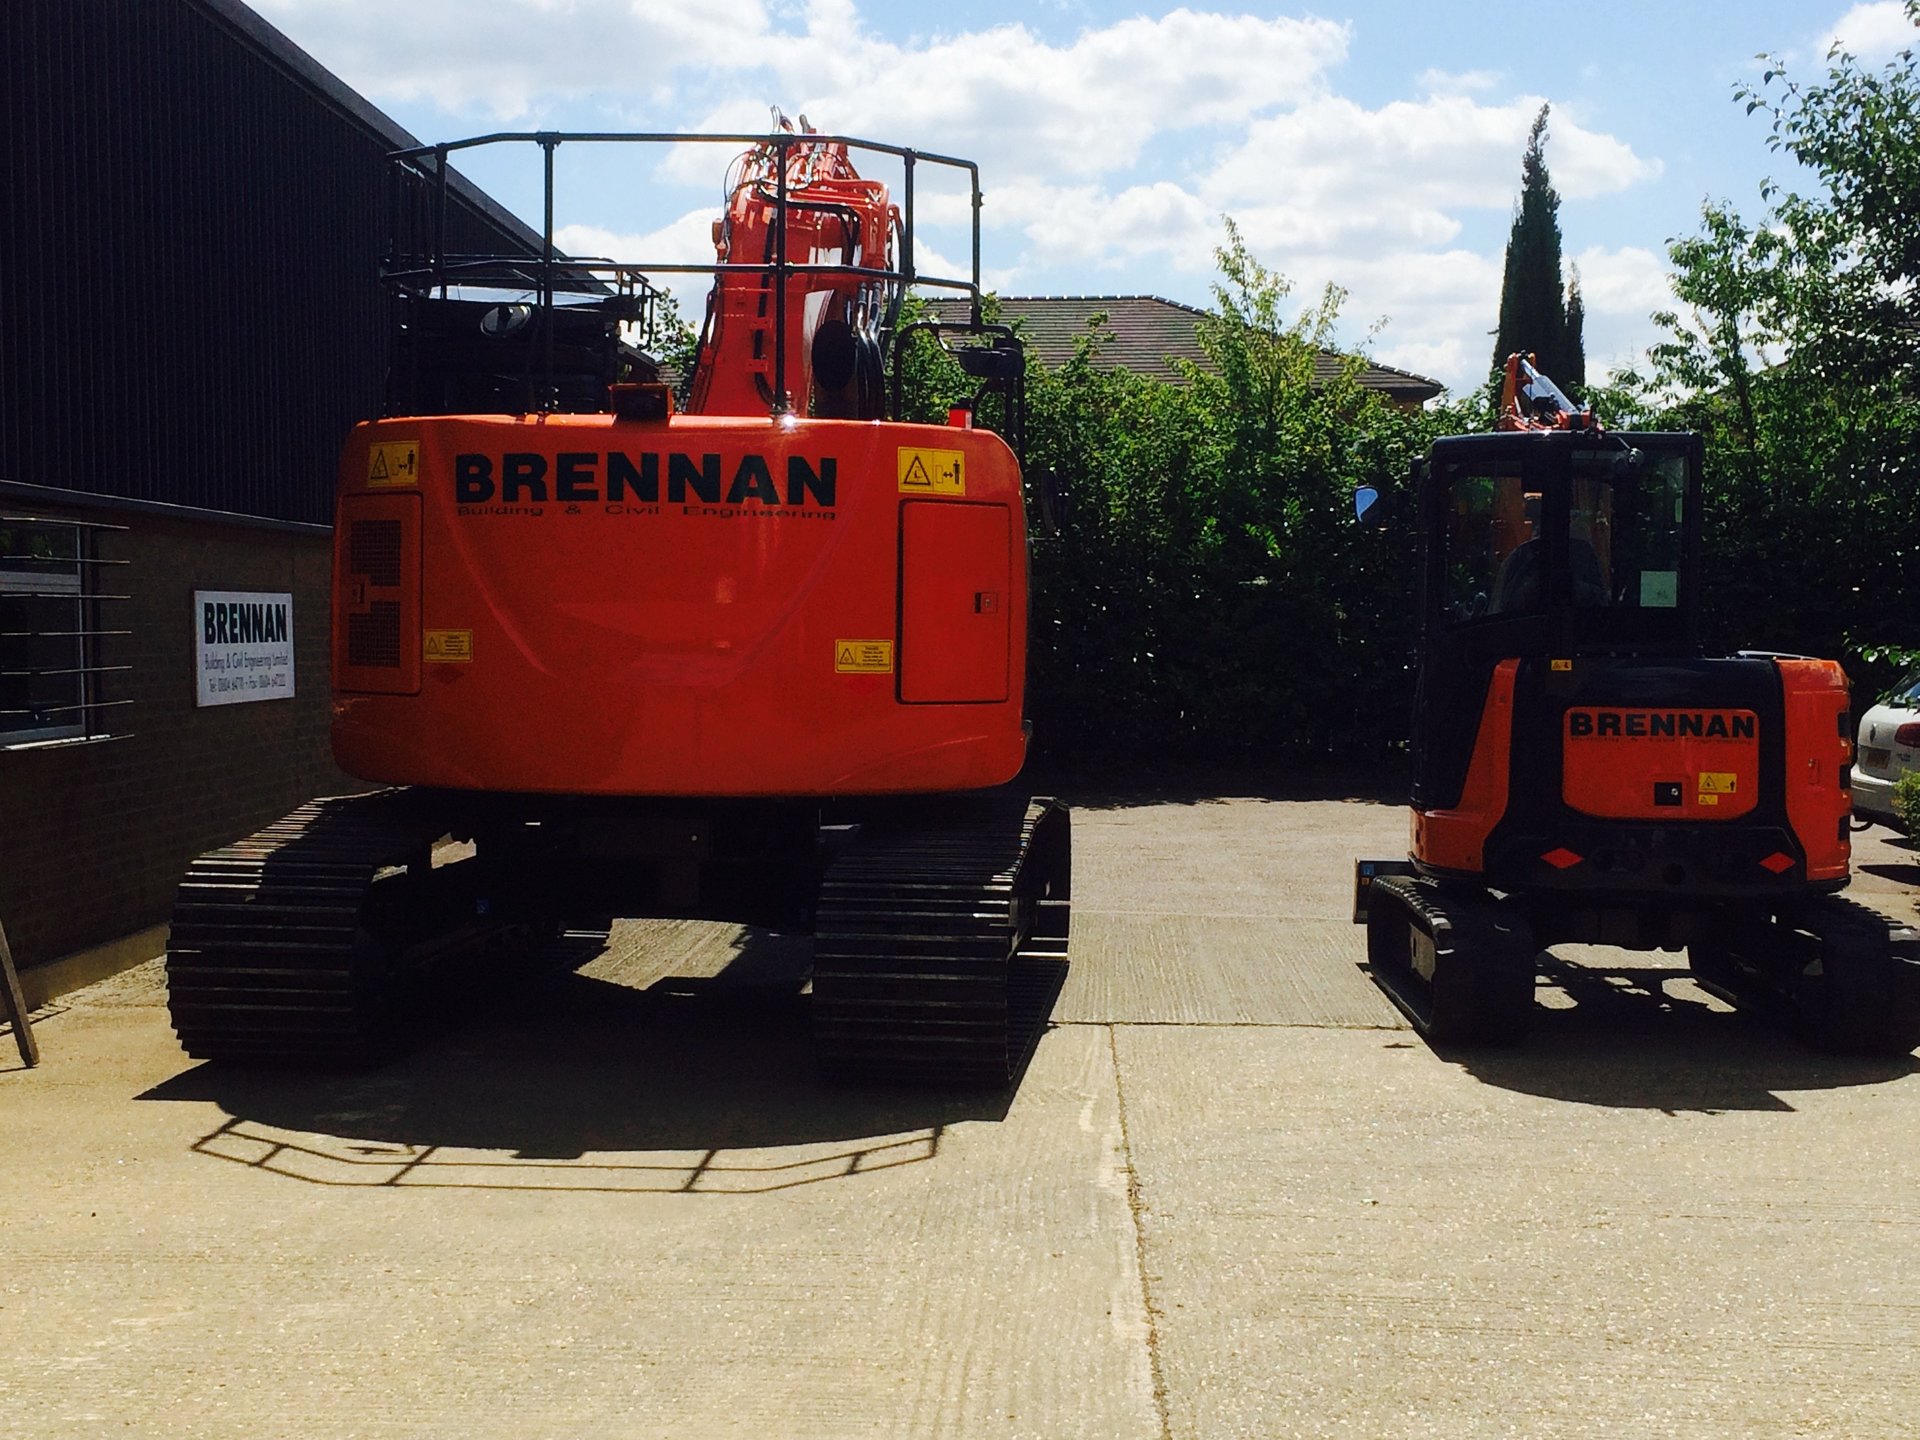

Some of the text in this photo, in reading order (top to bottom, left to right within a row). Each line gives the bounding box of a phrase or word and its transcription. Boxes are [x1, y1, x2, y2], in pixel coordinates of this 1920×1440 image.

[455, 452, 837, 507] BRENNAN
[457, 505, 544, 517] Building
[565, 504, 581, 515] &
[605, 504, 660, 515] Civil
[204, 602, 288, 644] BRENNAN
[1569, 713, 1755, 738] BRENNAN
